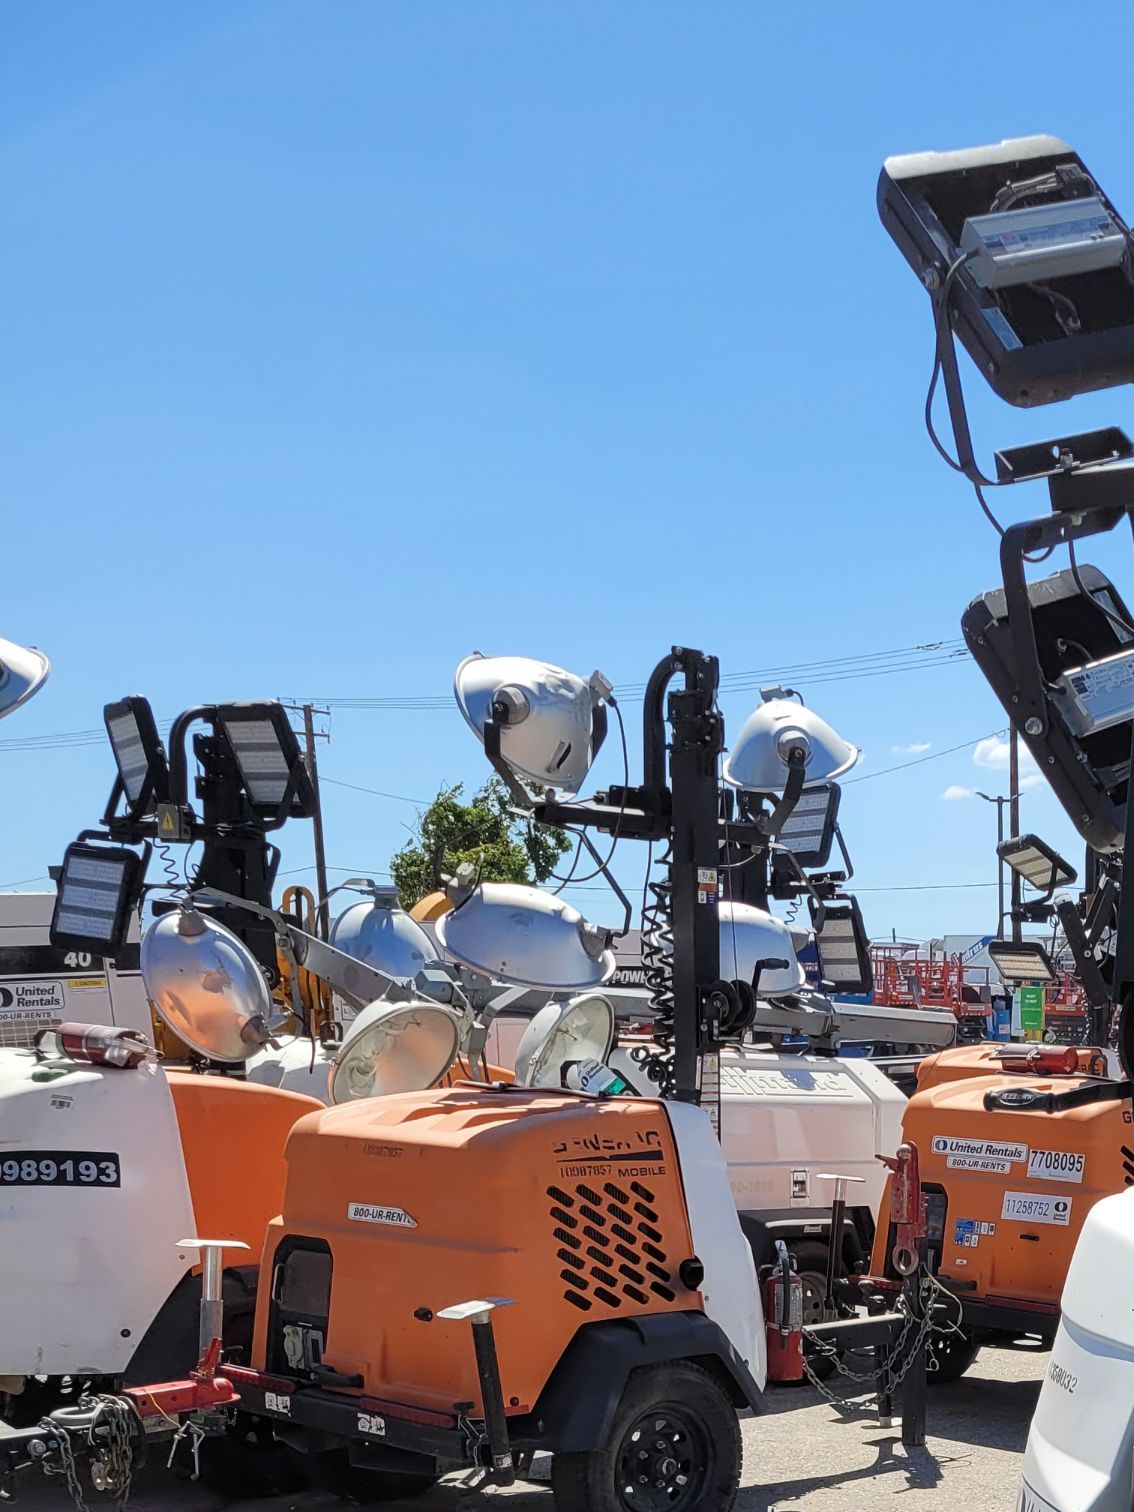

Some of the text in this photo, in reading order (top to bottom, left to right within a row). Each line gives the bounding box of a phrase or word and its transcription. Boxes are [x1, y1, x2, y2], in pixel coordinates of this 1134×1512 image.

[64, 952, 92, 967] 40
[15, 986, 55, 997] United
[17, 997, 60, 1007] Rentals
[950, 1142, 1023, 1159] United Rentals
[951, 1158, 1007, 1172] 800-UR-RENTS
[1030, 1150, 1083, 1172] 7708095
[0, 1159, 118, 1183] 989193
[617, 1166, 666, 1178] MOBILE
[1006, 1199, 1050, 1217] 11258752
